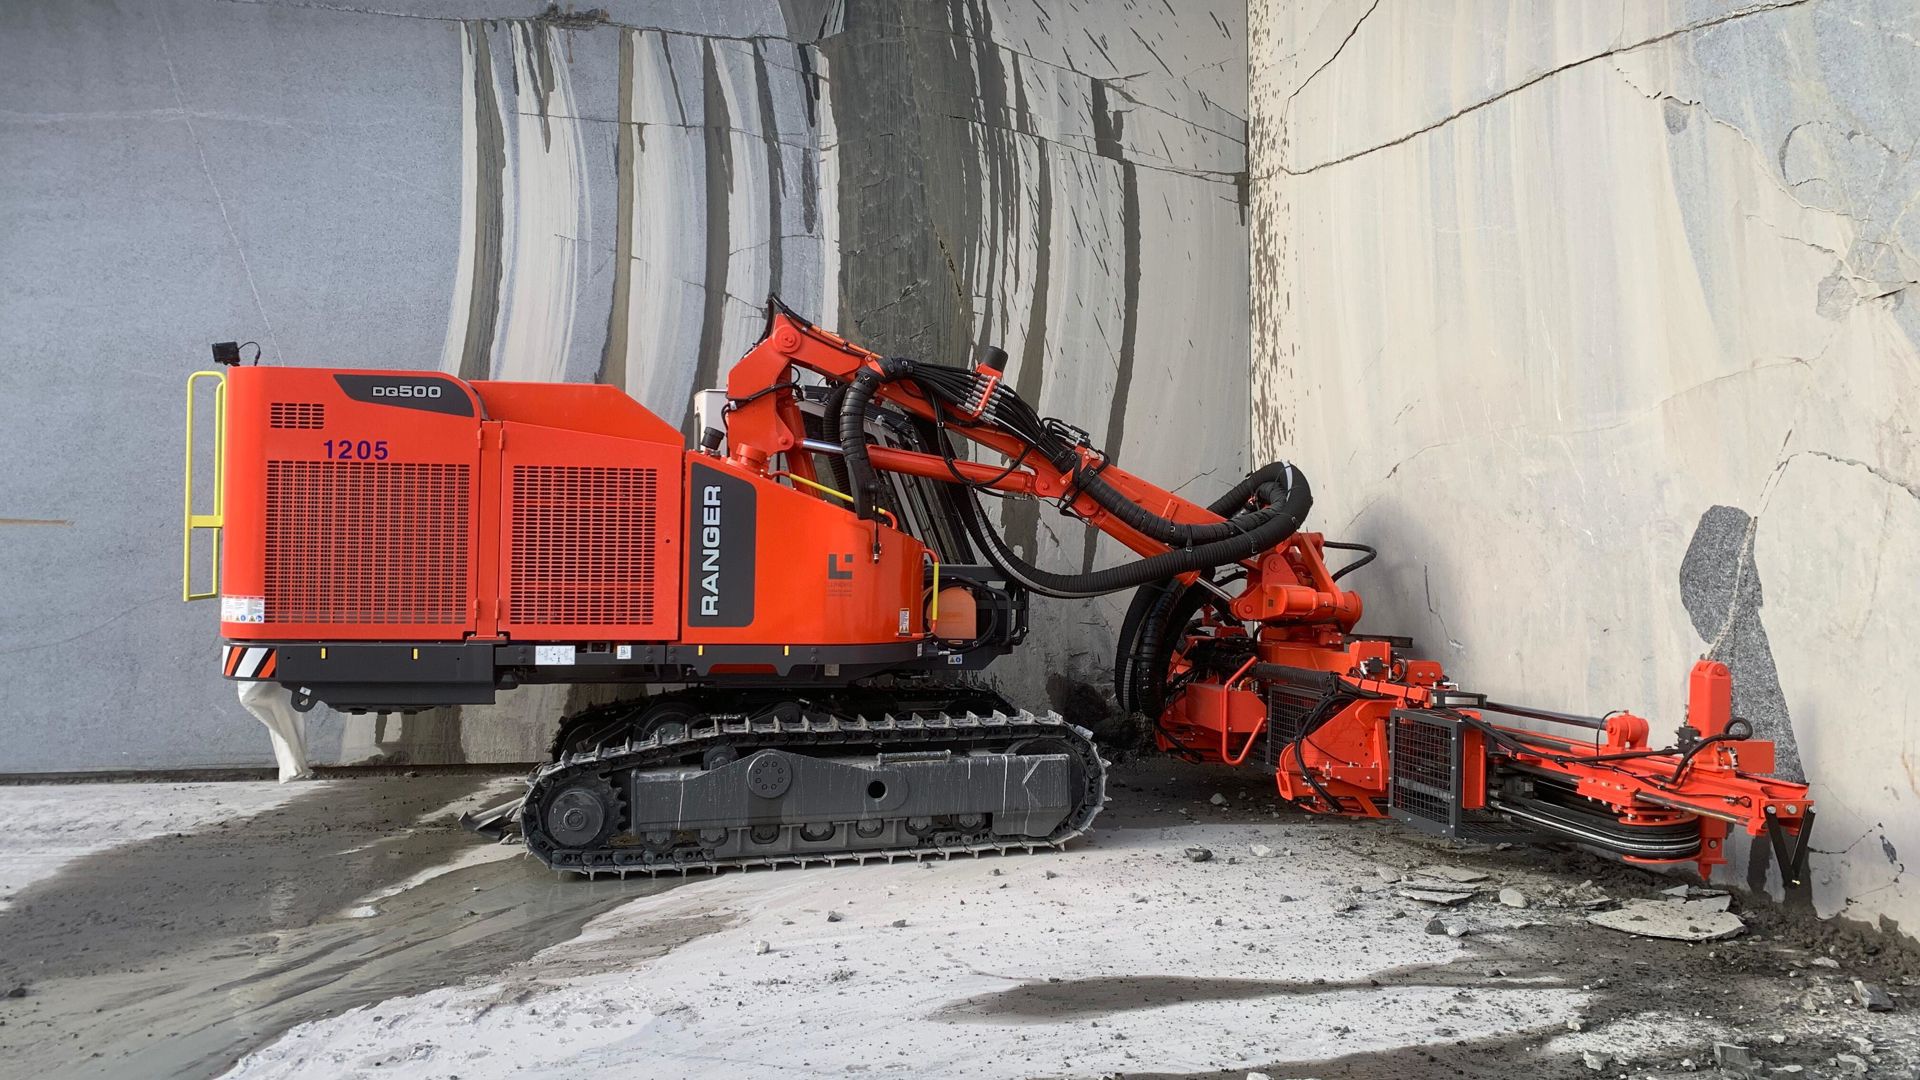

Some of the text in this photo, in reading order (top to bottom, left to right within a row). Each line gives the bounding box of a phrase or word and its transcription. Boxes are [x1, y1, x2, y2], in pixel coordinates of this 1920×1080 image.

[372, 385, 441, 398] DQ500
[323, 439, 389, 460] 1205
[700, 485, 721, 616] RANGER
